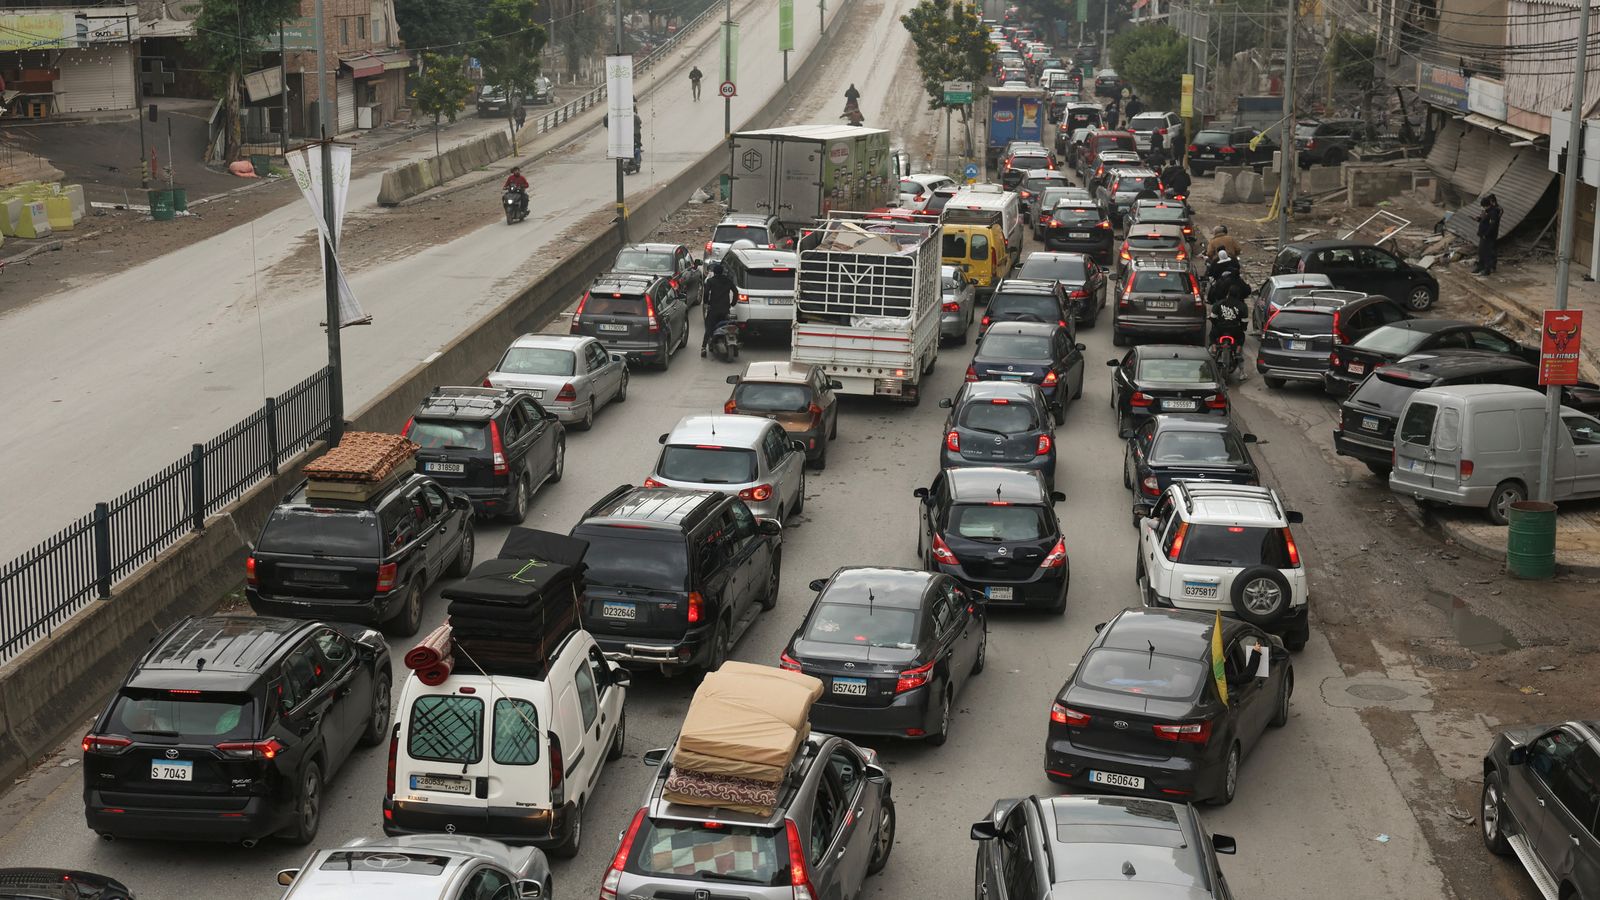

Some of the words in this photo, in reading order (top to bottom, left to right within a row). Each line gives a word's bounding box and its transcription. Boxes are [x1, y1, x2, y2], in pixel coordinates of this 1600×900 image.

[1185, 586, 1216, 597] G375817
[833, 683, 867, 695] G574217
[152, 767, 159, 778] S
[164, 767, 187, 780] 7043
[1096, 772, 1102, 782] G
[1106, 773, 1140, 788] 650643
